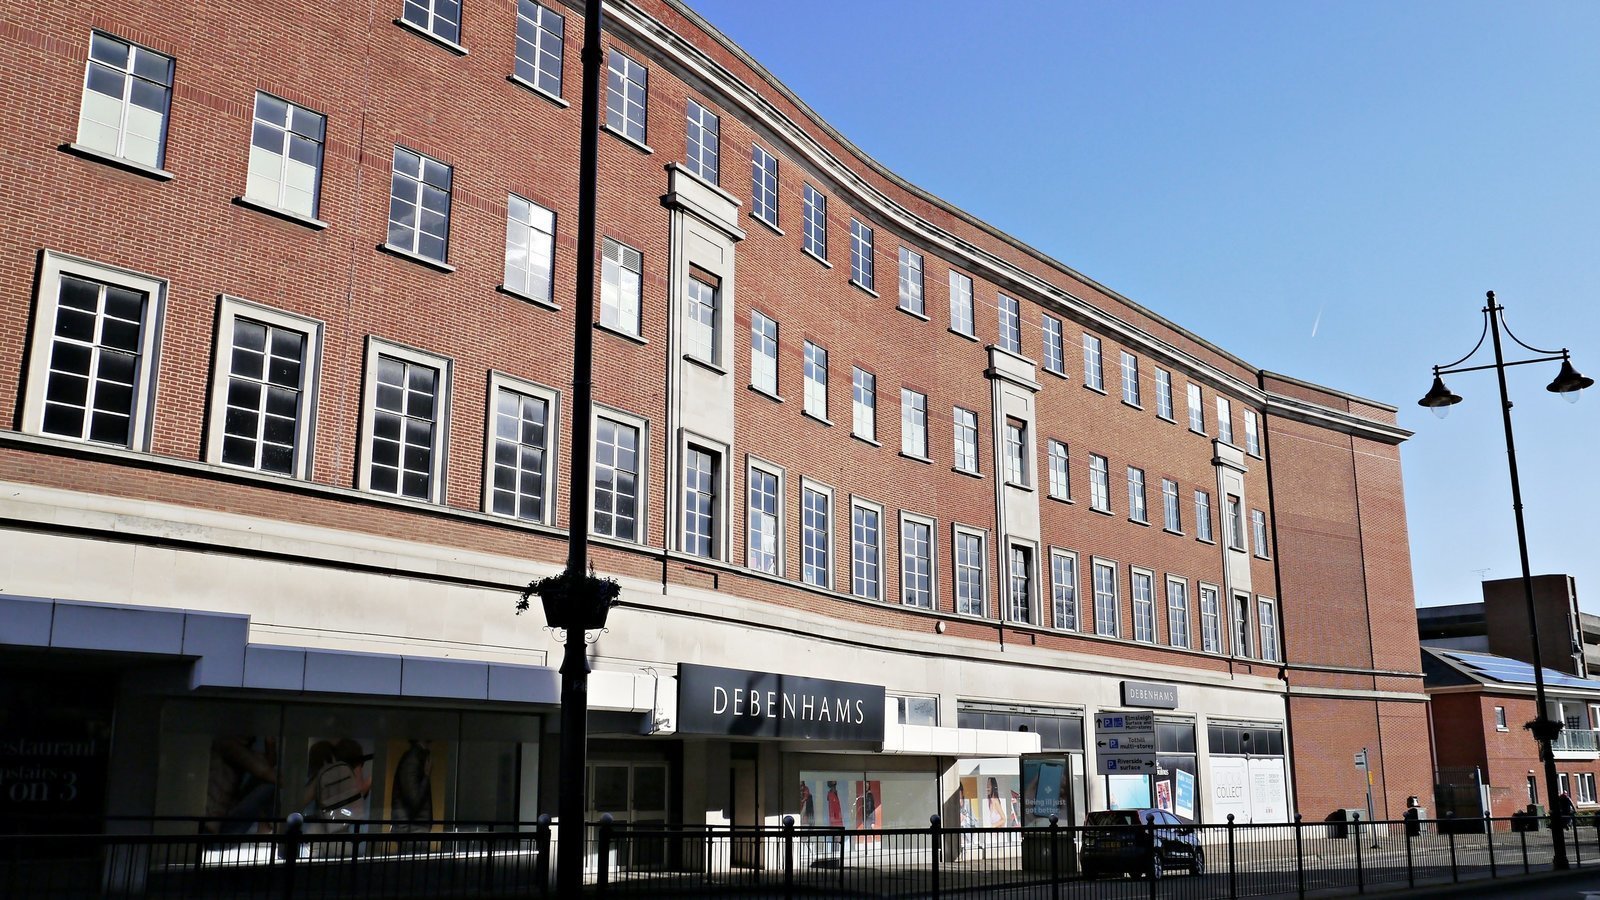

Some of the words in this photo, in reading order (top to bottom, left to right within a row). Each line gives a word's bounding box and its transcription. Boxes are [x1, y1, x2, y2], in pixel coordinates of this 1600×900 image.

[1130, 688, 1174, 702] DEBENHAMS
[712, 685, 865, 725] DEBENHAMS
[9, 782, 49, 802] on
[60, 770, 77, 802] 3
[1216, 786, 1243, 799] COLLECT
[1025, 799, 1044, 807] Being
[1052, 798, 1066, 807] just
[1025, 807, 1036, 815] got
